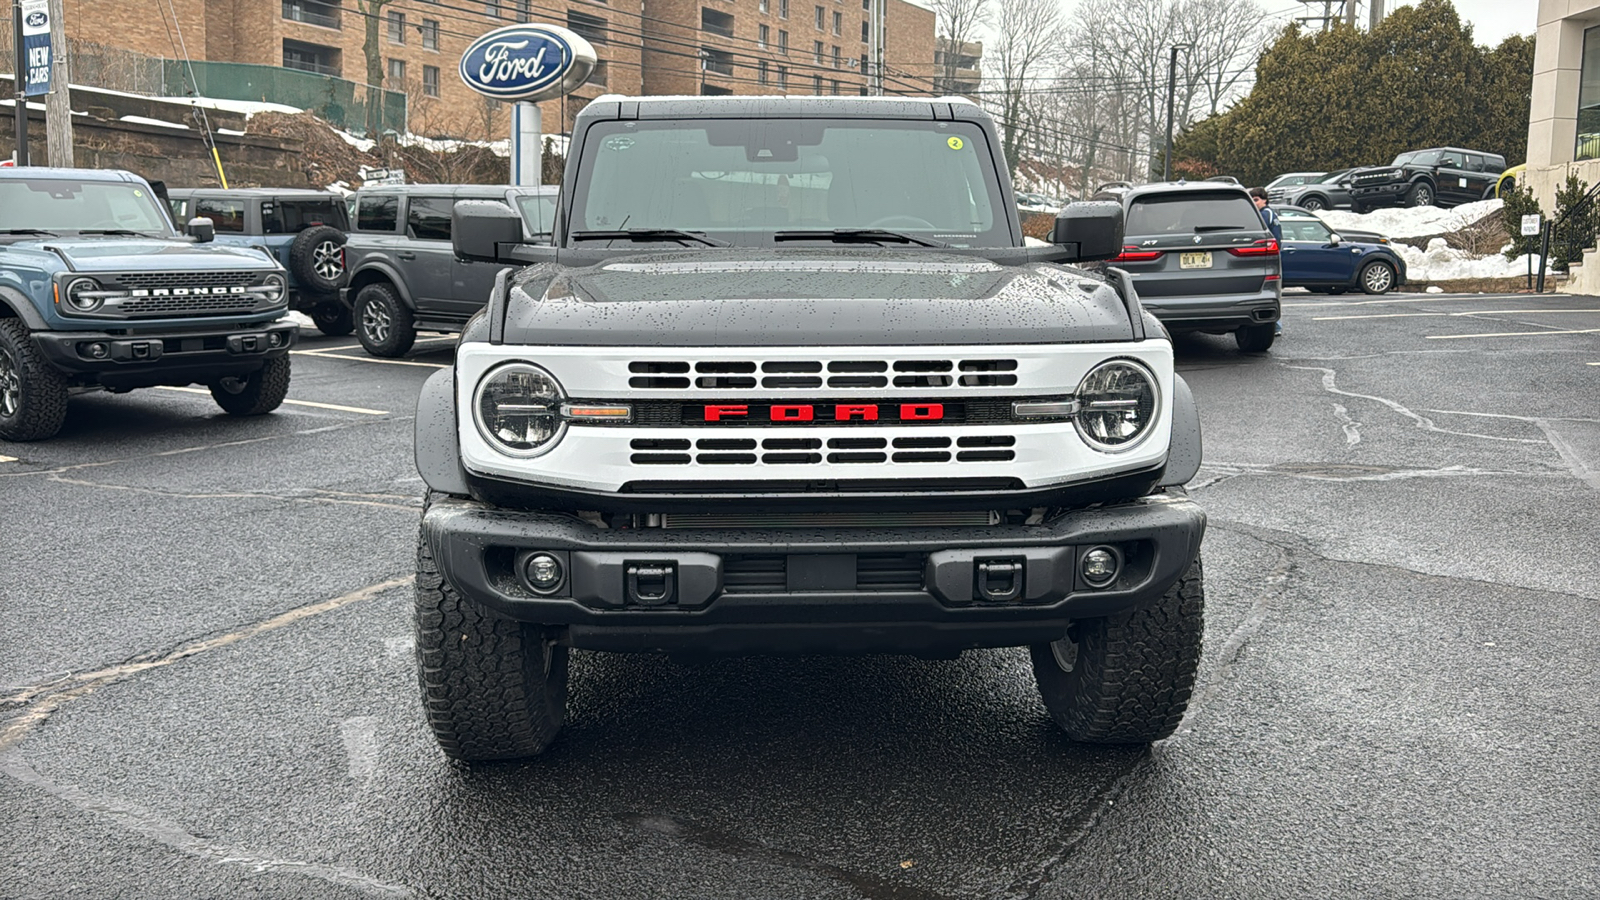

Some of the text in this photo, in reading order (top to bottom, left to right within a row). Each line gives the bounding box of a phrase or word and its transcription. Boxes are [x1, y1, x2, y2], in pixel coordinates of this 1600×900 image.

[29, 13, 45, 26] Ford
[29, 46, 49, 67] NEW
[479, 39, 547, 84] Ford
[30, 67, 49, 84] CARS
[952, 139, 959, 148] 2
[132, 286, 245, 297] BRONCO
[704, 403, 943, 420] FORD
